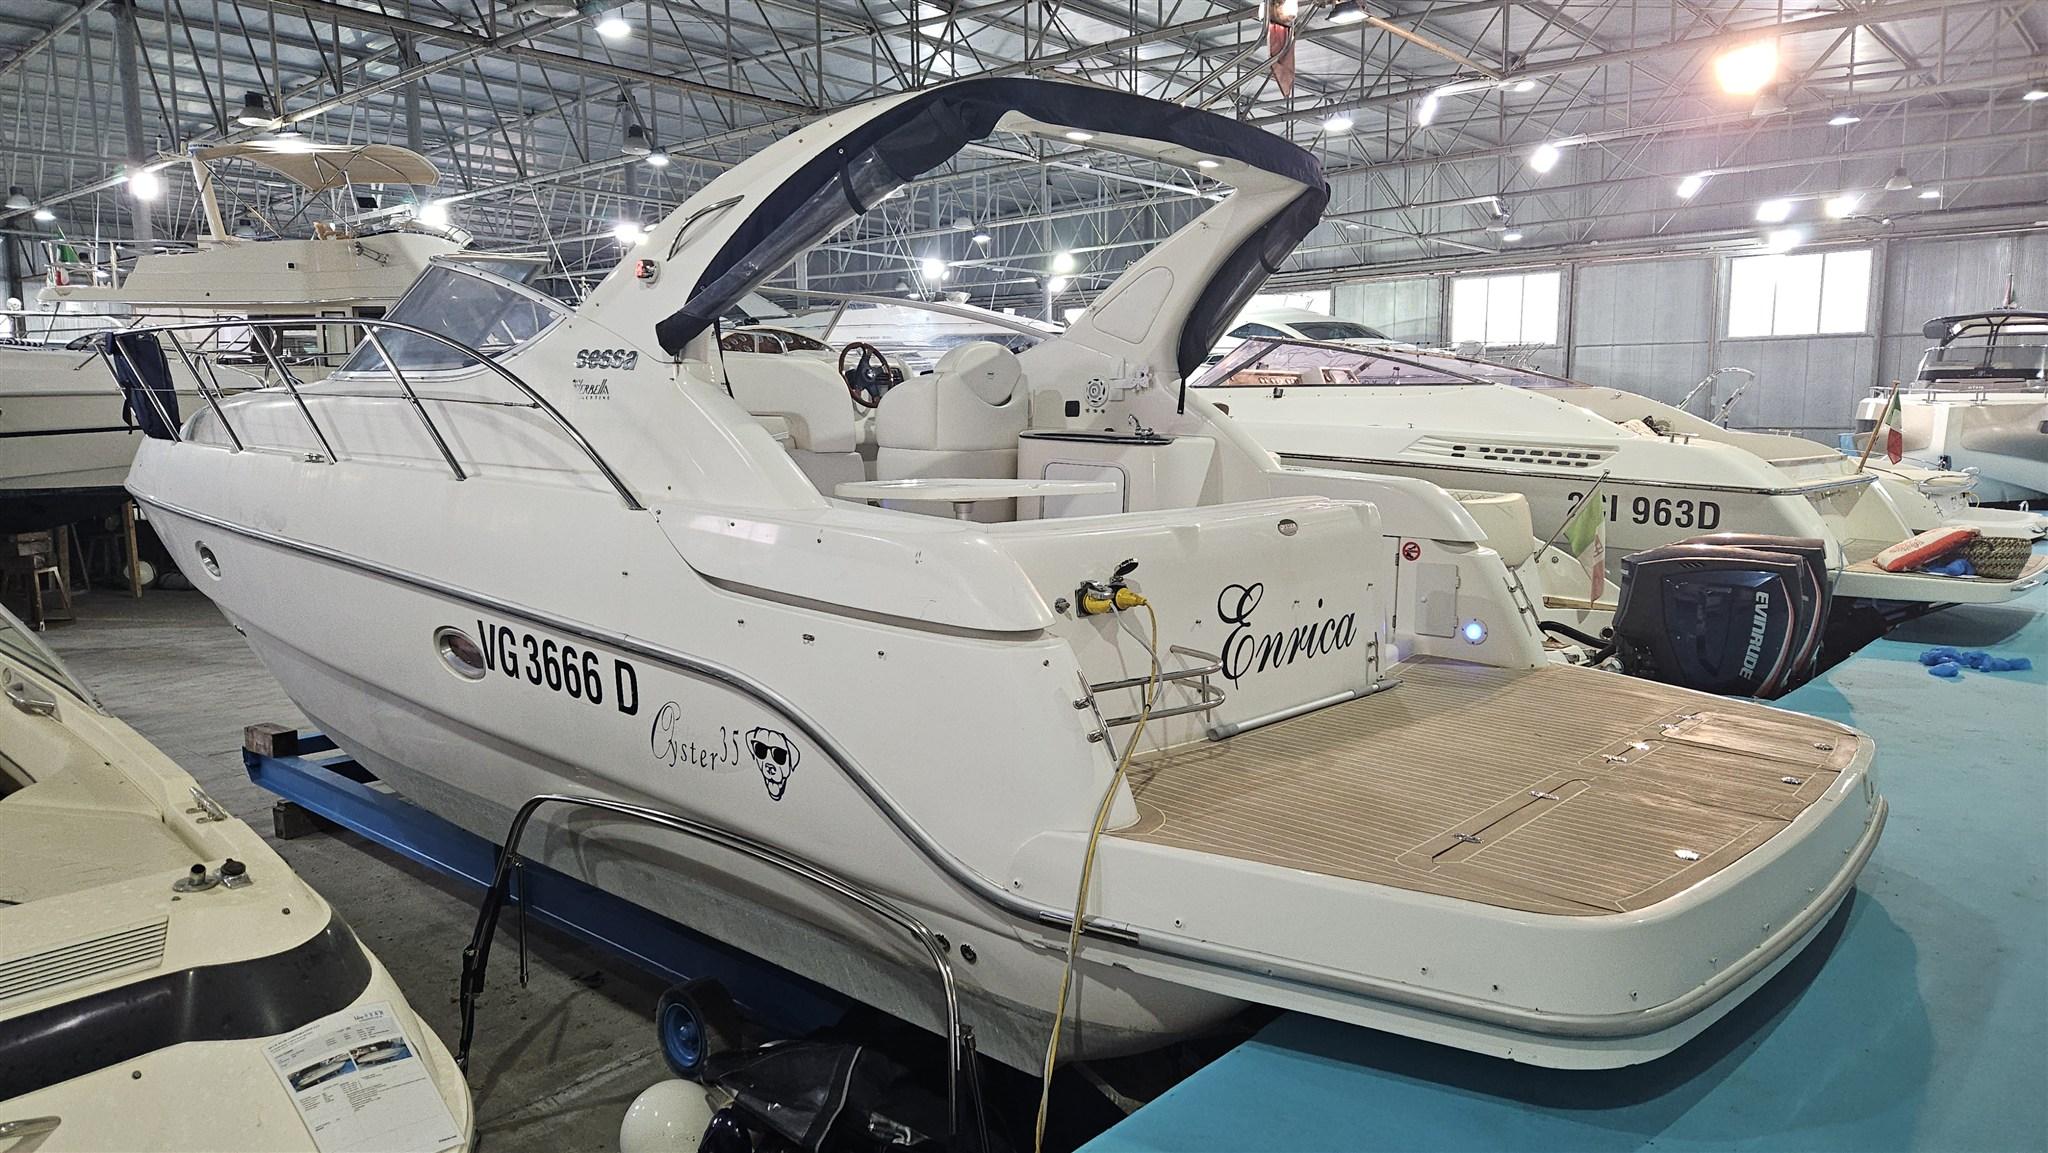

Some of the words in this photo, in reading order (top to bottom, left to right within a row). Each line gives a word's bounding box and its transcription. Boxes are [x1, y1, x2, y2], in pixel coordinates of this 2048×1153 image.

[575, 348, 638, 371] sessa
[1632, 496, 1721, 530] 963D
[477, 620, 520, 679] VG
[522, 634, 603, 705] 3666
[614, 659, 639, 716] D
[1217, 582, 1357, 690] Enrica
[1739, 591, 1769, 680] EVINRUDE
